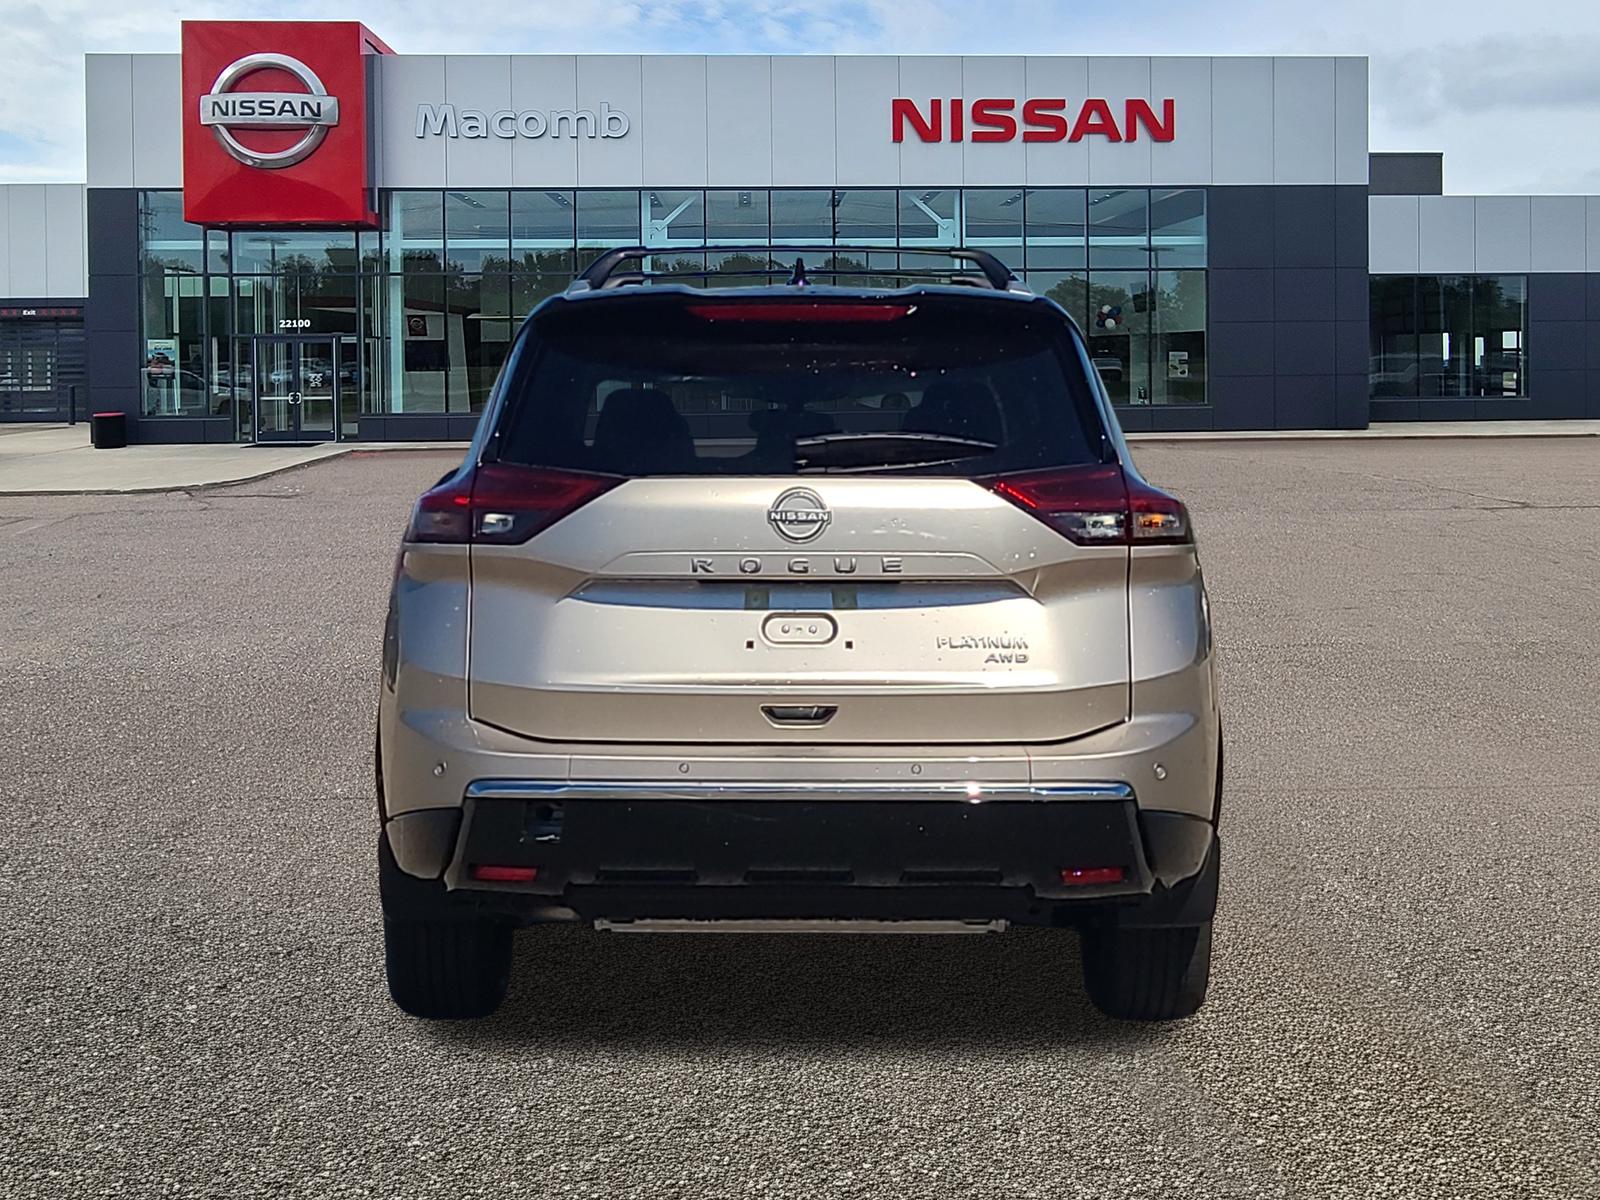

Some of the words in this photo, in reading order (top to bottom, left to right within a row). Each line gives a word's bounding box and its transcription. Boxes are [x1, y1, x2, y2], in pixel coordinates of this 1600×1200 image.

[211, 100, 322, 118] NISSAN
[415, 101, 630, 139] Macomb
[891, 98, 1175, 143] NISSAN
[279, 319, 311, 328] 22100
[770, 511, 829, 521] NISSAN
[691, 557, 903, 574] ROGUE
[936, 636, 1029, 649] PLATINUM
[984, 653, 1029, 664] AWD
